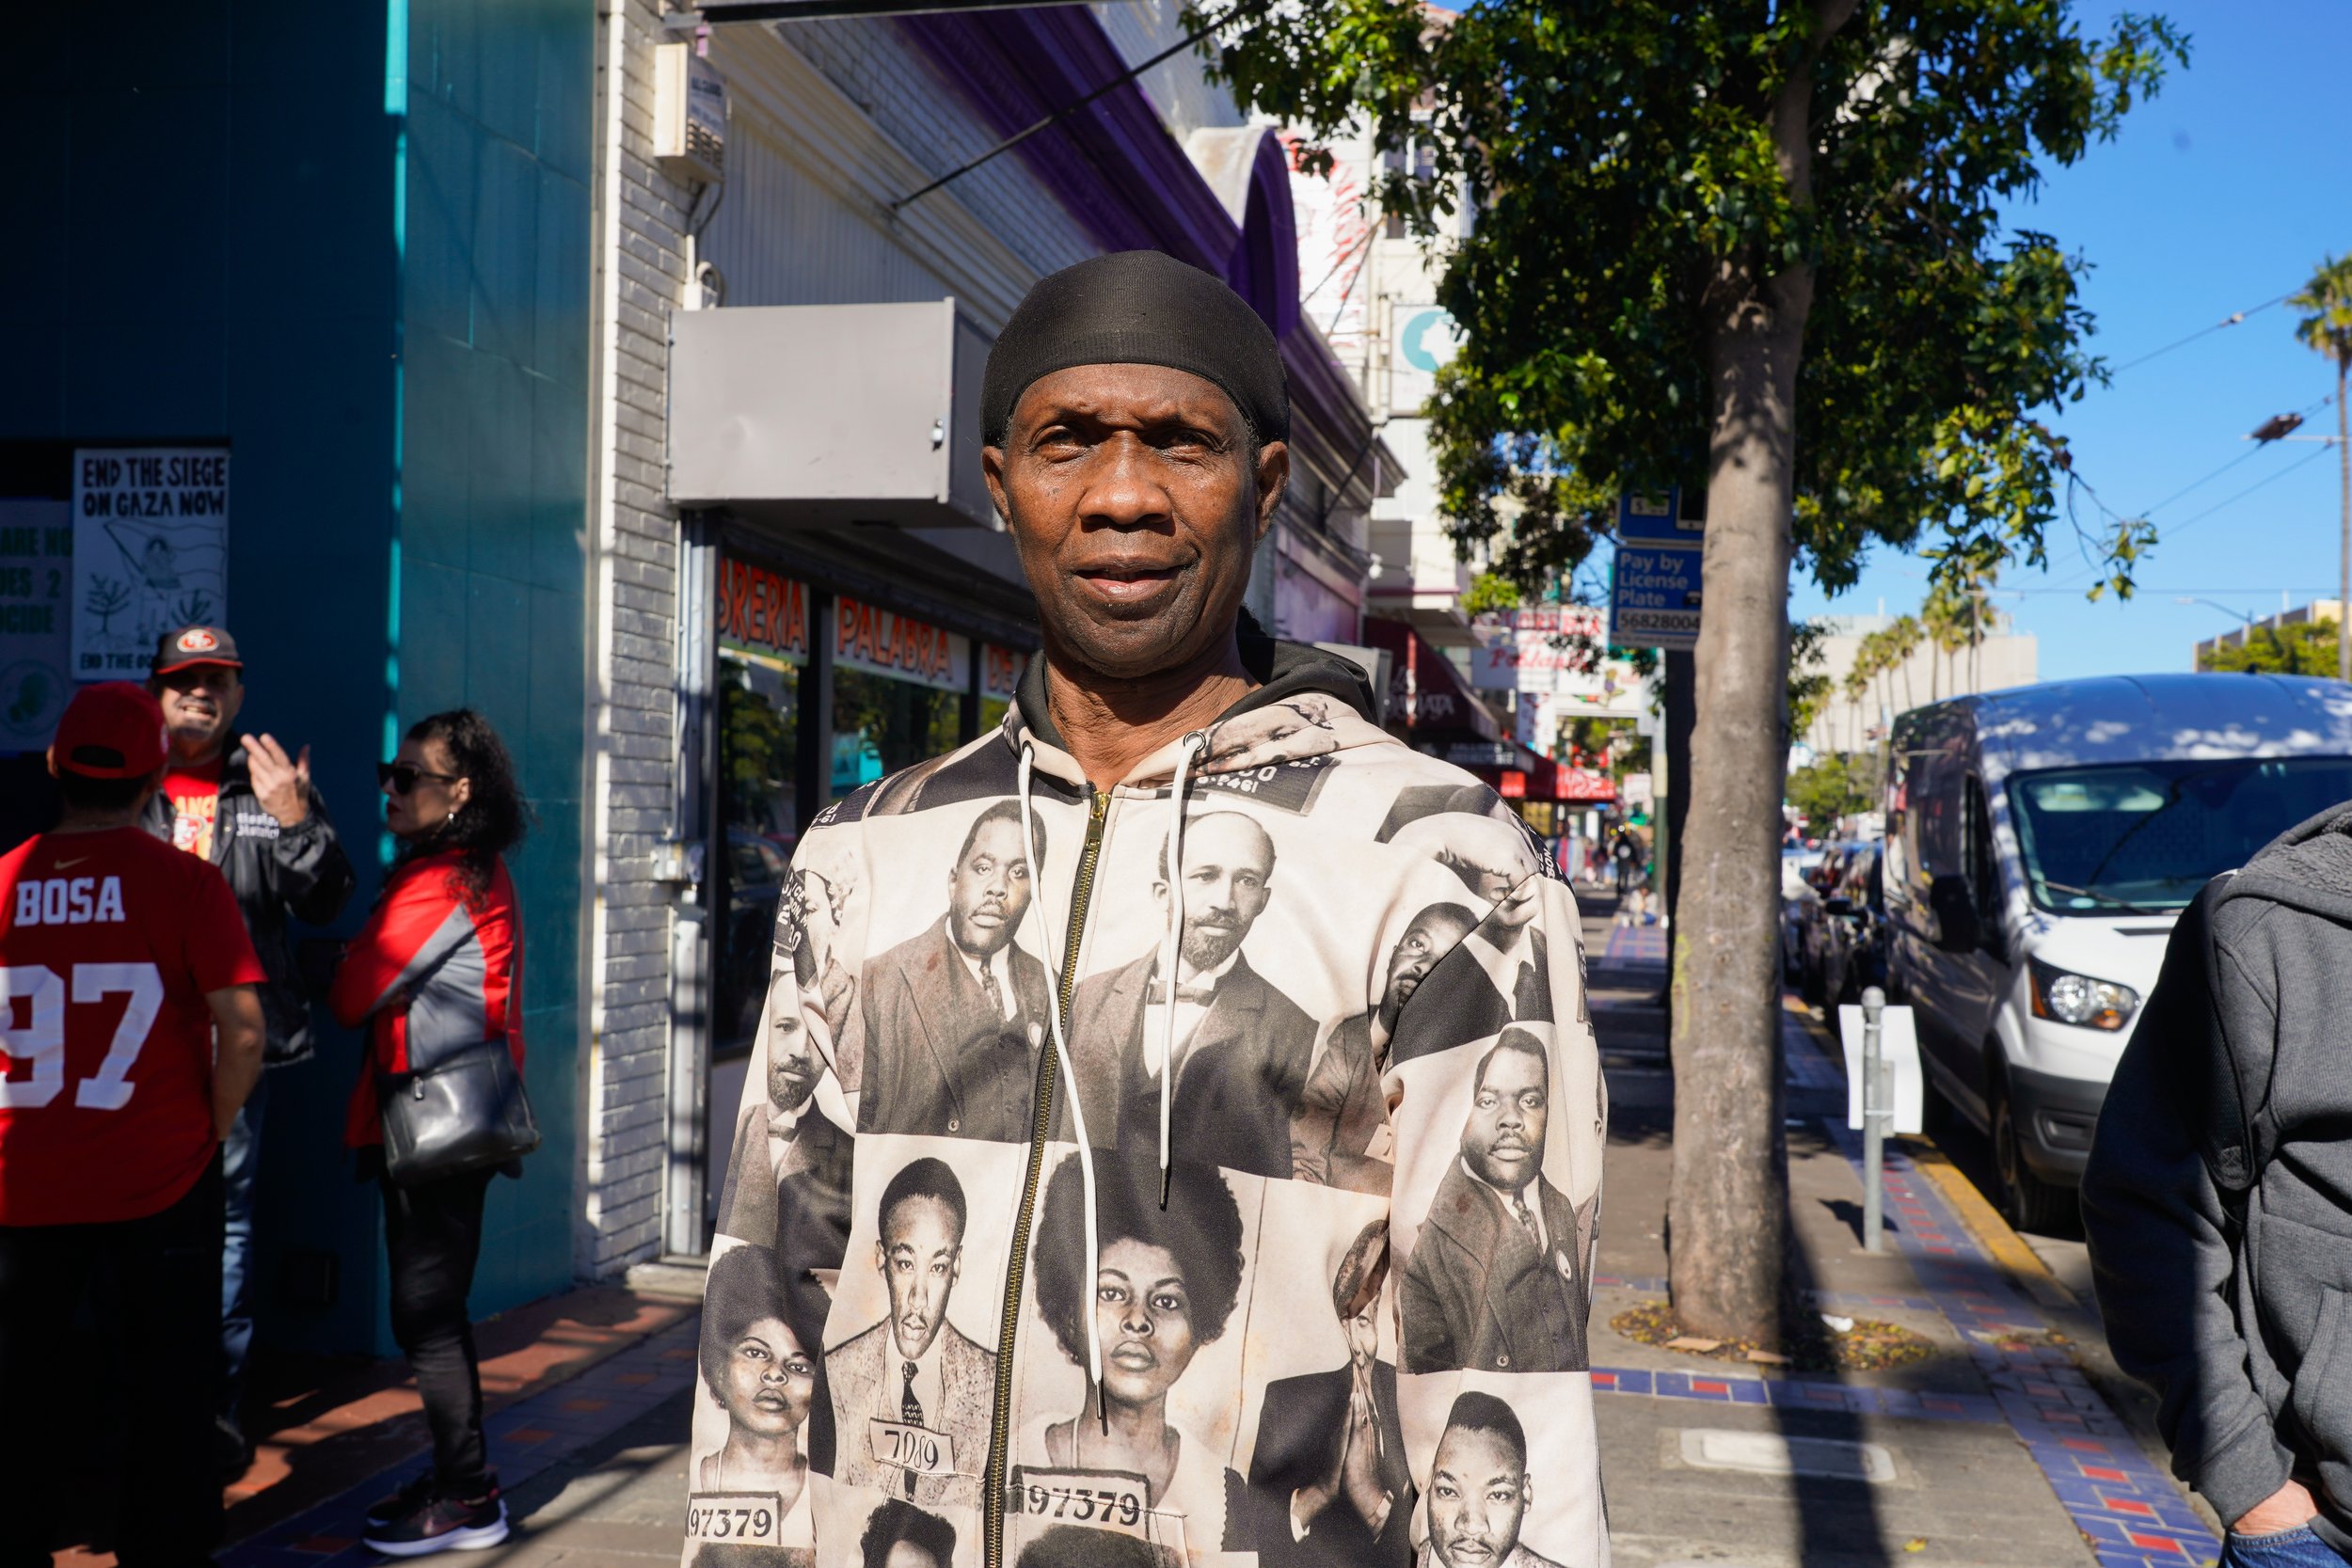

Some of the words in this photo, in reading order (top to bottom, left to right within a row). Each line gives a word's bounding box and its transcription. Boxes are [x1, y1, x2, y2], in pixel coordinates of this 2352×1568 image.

[83, 458, 120, 487] END
[126, 457, 163, 487] THE
[167, 455, 225, 487] SIEGE
[84, 491, 111, 516] ON
[117, 491, 173, 516] GAZA
[179, 490, 225, 515] NOW
[1620, 551, 1654, 575] Pay
[1660, 552, 1685, 575] by
[46, 567, 61, 598] 2
[1619, 570, 1690, 591] License
[1617, 588, 1666, 608] Plate
[838, 594, 953, 684] PALABRA
[105, 653, 134, 669] THE
[13, 875, 126, 927] BOSA
[0, 961, 166, 1111] 97
[883, 1429, 939, 1471] 7089
[689, 1507, 772, 1538] 97379
